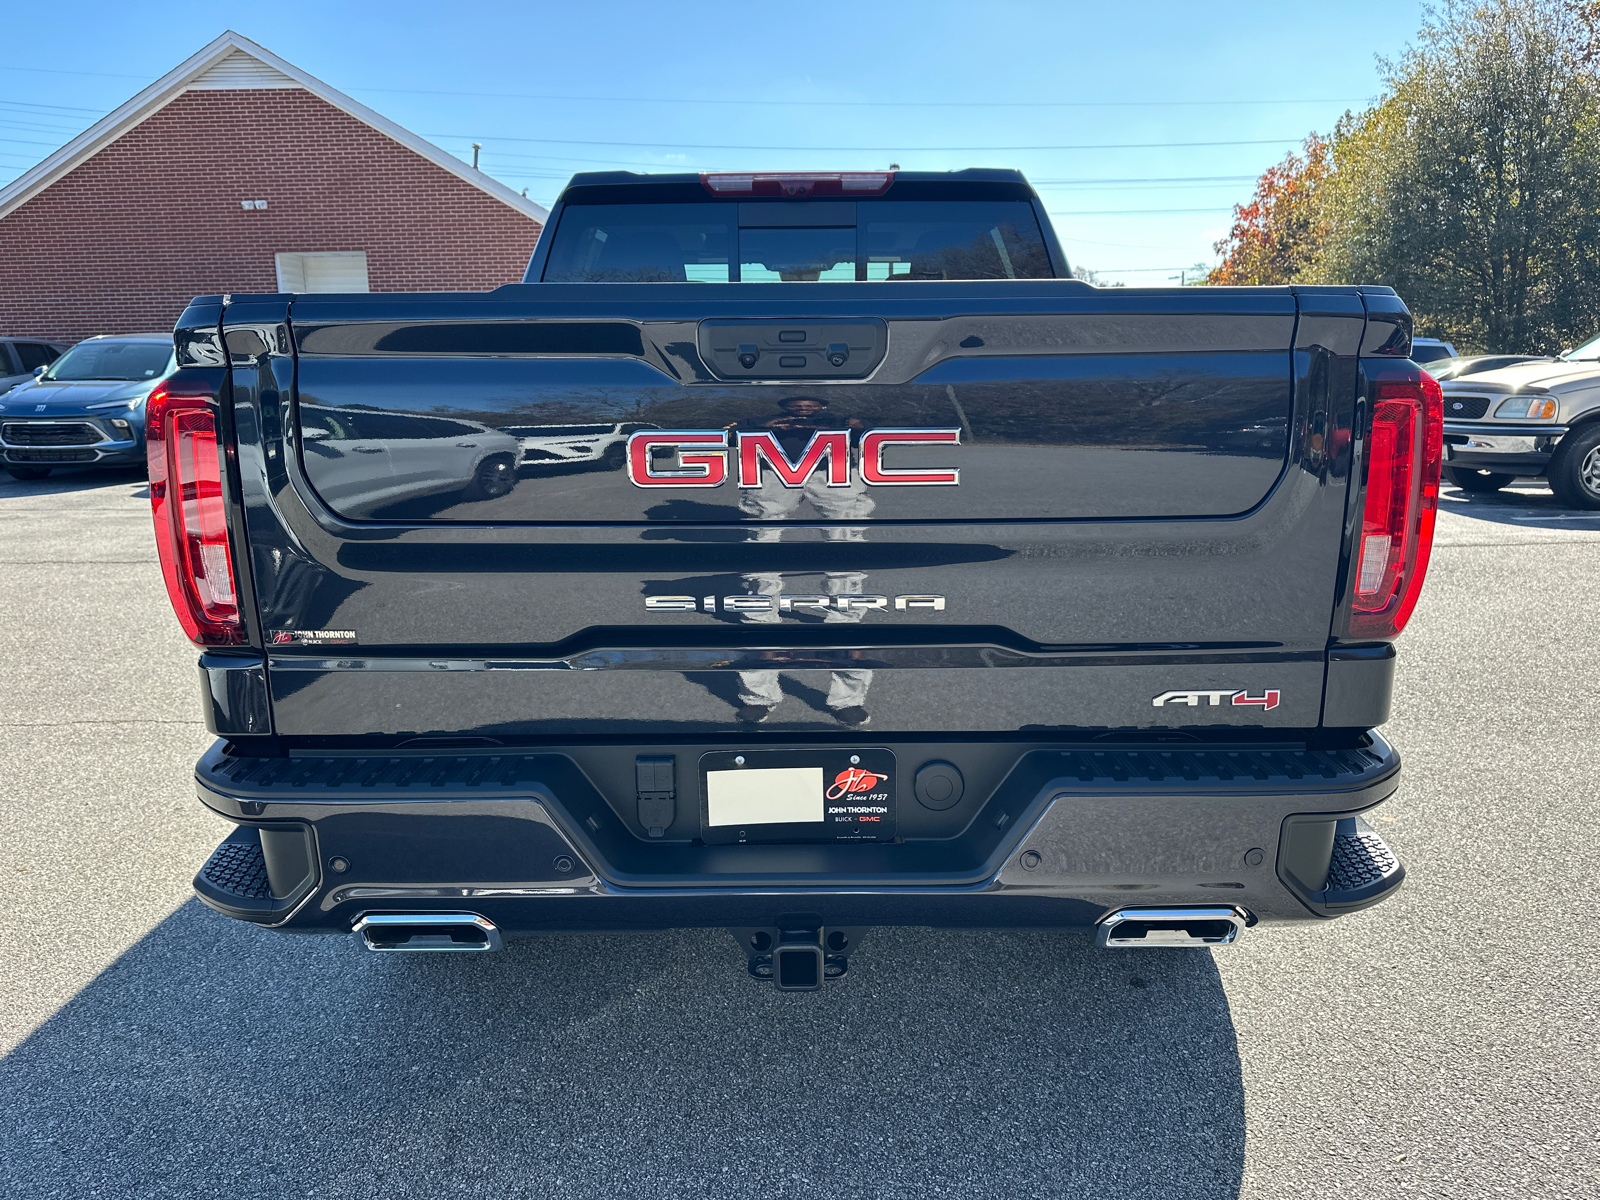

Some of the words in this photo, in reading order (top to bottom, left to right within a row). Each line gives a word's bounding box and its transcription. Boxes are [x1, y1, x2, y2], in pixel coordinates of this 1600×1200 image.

[626, 428, 961, 488] GMC
[645, 594, 946, 613] SIERRA
[1152, 689, 1280, 711] AT4
